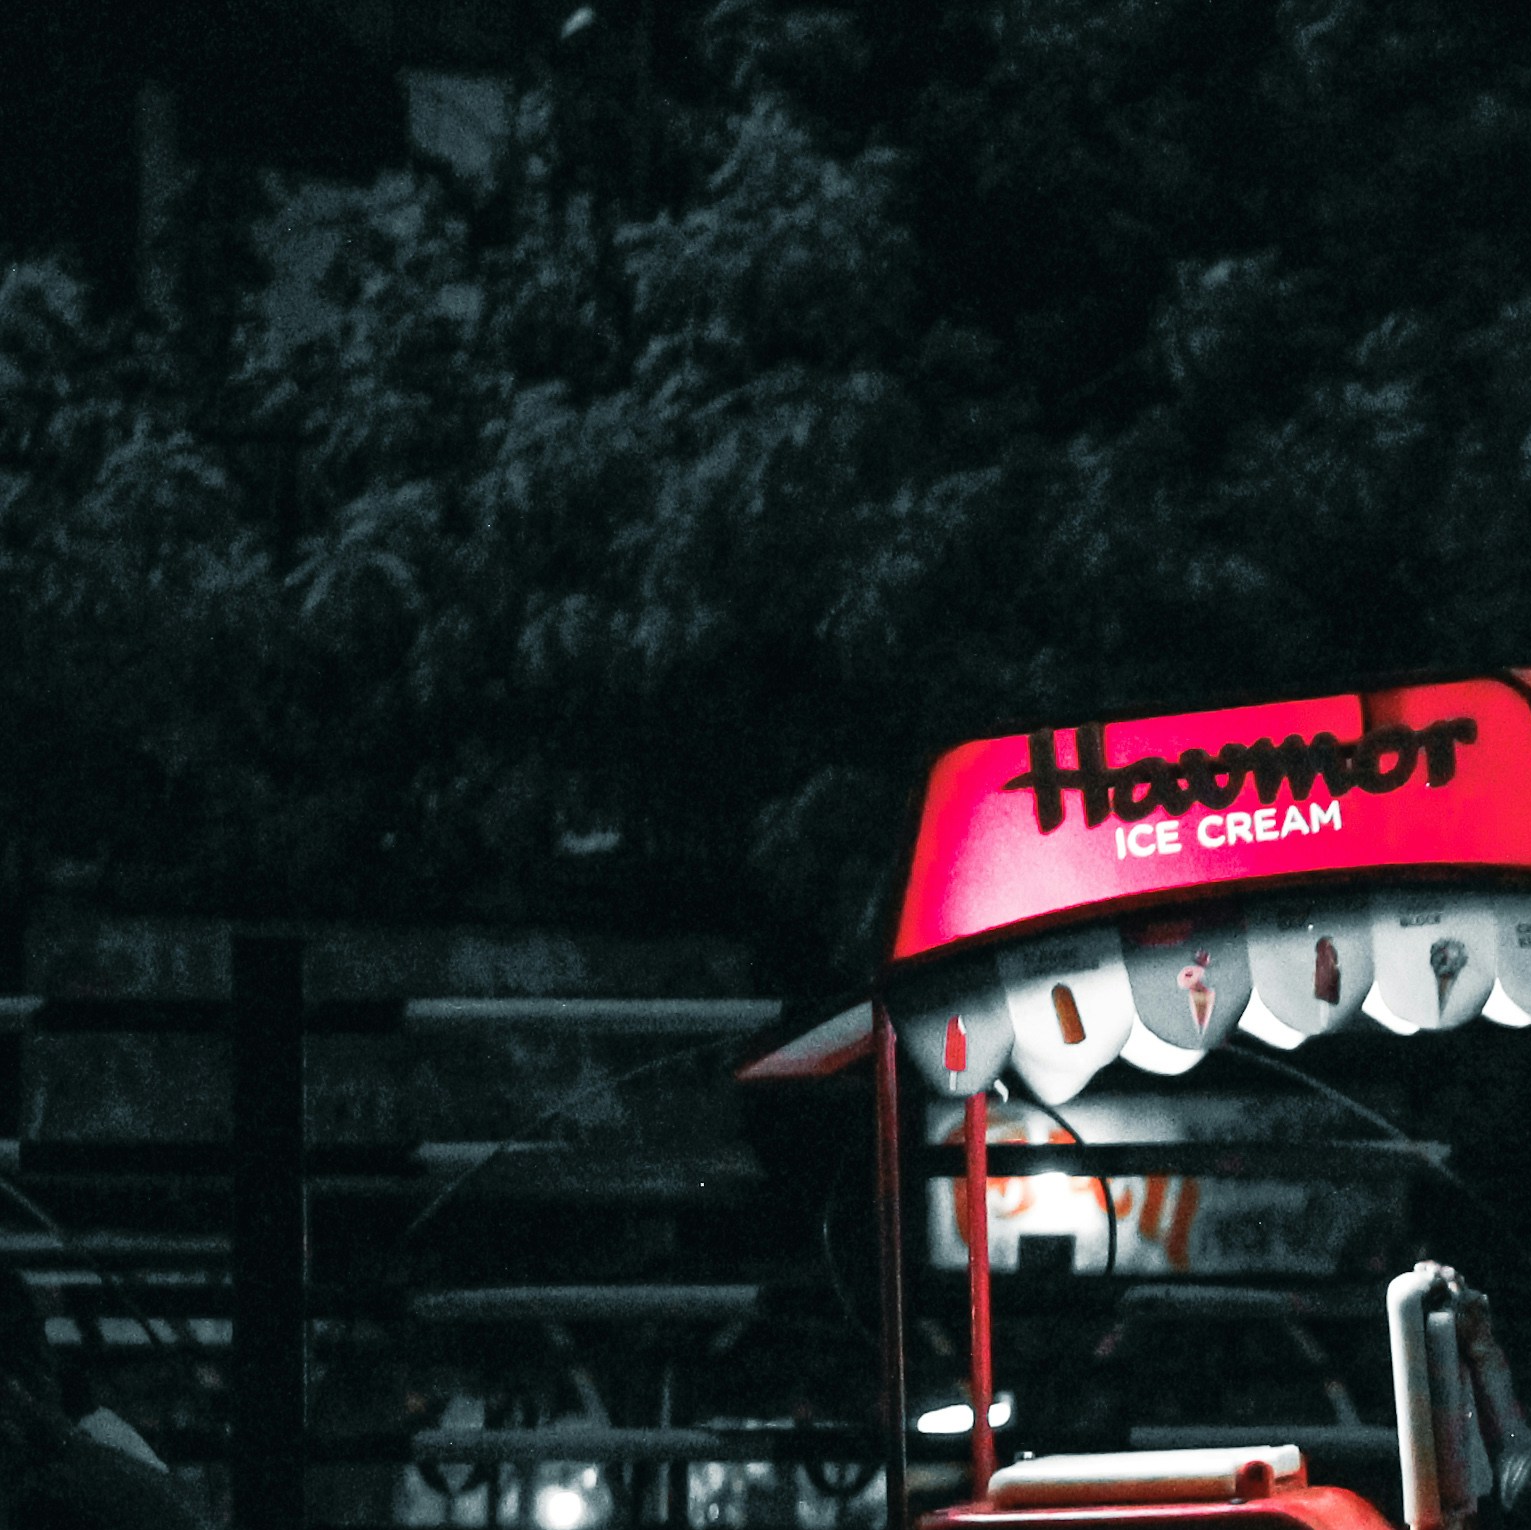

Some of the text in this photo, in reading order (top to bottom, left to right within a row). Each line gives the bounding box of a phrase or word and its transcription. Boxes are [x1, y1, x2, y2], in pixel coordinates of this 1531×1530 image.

[1001, 717, 1478, 835] Havmor
[1115, 799, 1343, 859] ICE CREAM
